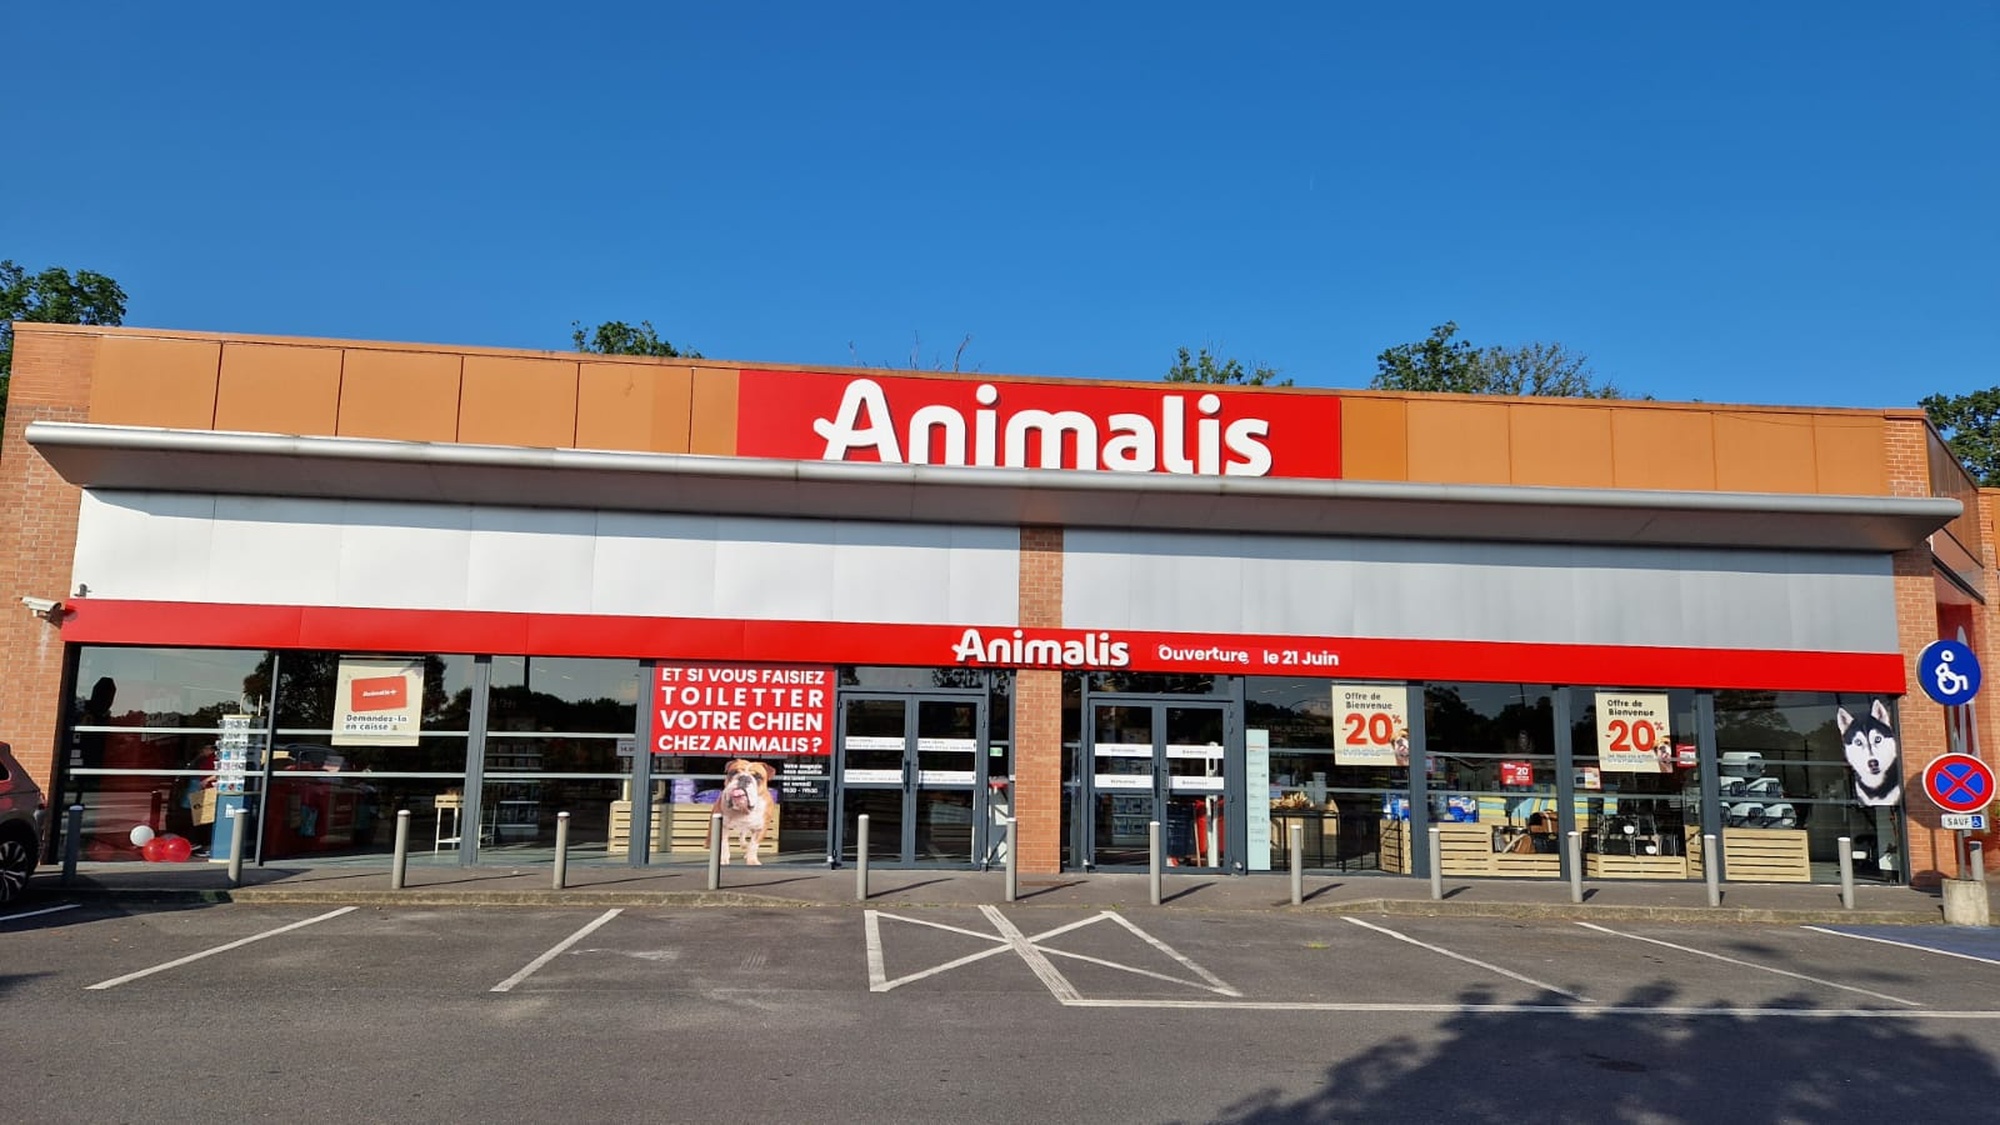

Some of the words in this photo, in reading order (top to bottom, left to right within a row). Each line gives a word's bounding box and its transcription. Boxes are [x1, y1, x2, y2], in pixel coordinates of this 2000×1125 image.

[813, 378, 1272, 476] Animalis
[952, 628, 1130, 667] Animalis
[1158, 645, 1249, 664] Ouverture
[1263, 650, 1279, 665] le
[1282, 651, 1298, 665] 21
[1302, 650, 1339, 666] Juin
[662, 668, 682, 682] ET
[687, 668, 703, 682] SI
[708, 669, 757, 683] VOUS
[762, 670, 825, 684] FAISIEZ
[661, 686, 824, 708] TOILETTER
[1345, 692, 1368, 700] Offre
[1370, 692, 1381, 700] de
[1607, 699, 1629, 707] Offre
[1632, 699, 1643, 707] de
[1345, 701, 1393, 709] Bienvenue
[1608, 708, 1654, 716] Bienvenue
[660, 710, 741, 730] VOTRE
[748, 712, 823, 732] CHIEN
[658, 735, 711, 751] CHEZ
[714, 736, 809, 752] ANIMALIS
